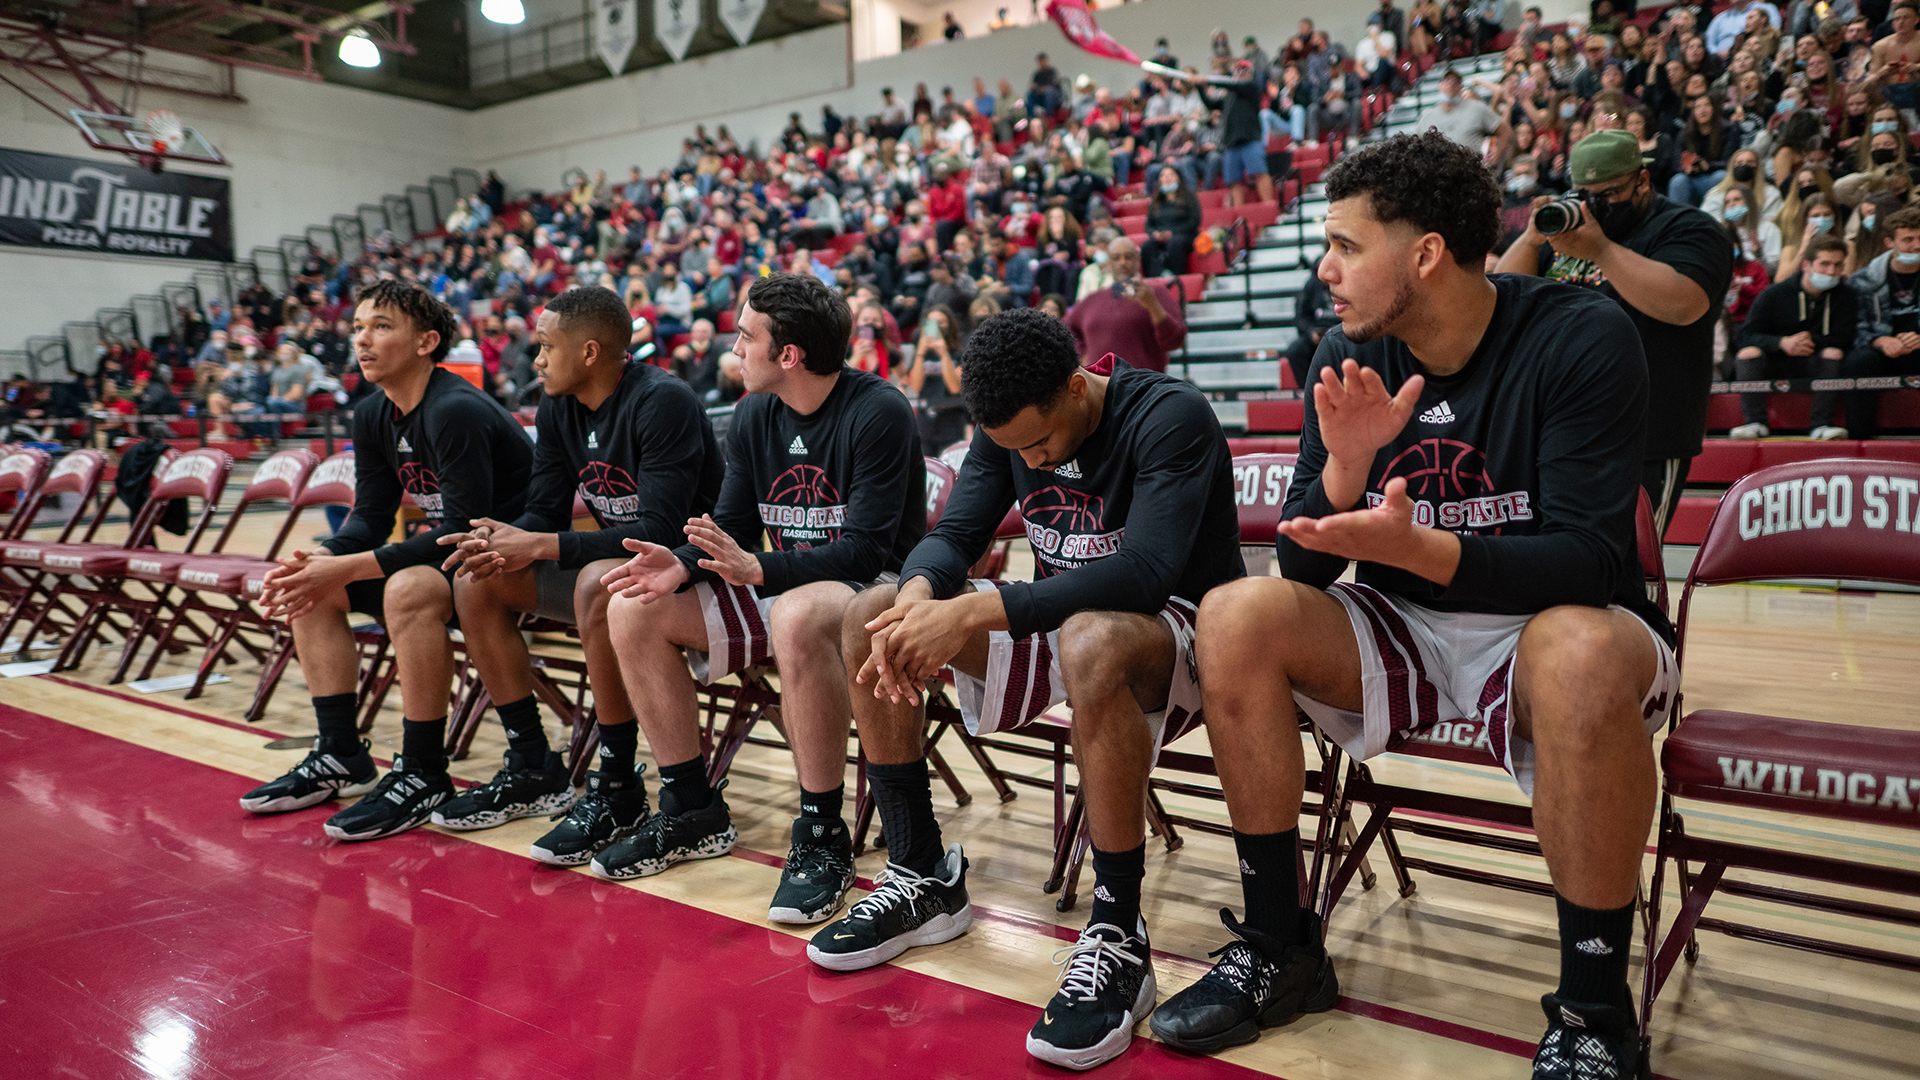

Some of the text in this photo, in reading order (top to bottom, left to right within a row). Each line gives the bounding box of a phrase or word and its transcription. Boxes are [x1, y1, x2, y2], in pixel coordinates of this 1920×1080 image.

[71, 167, 219, 238] TABLE
[42, 226, 192, 256] PIZZA ROYALTY
[1419, 413, 1455, 424] adidas
[1054, 467, 1082, 479] adidas
[758, 503, 805, 528] HICO
[1439, 491, 1533, 528] STATE
[1739, 475, 1853, 541] CHICO
[782, 529, 827, 539] BASKETBALL
[1717, 756, 1920, 812] WILDCA
[1576, 941, 1613, 955] adidas
